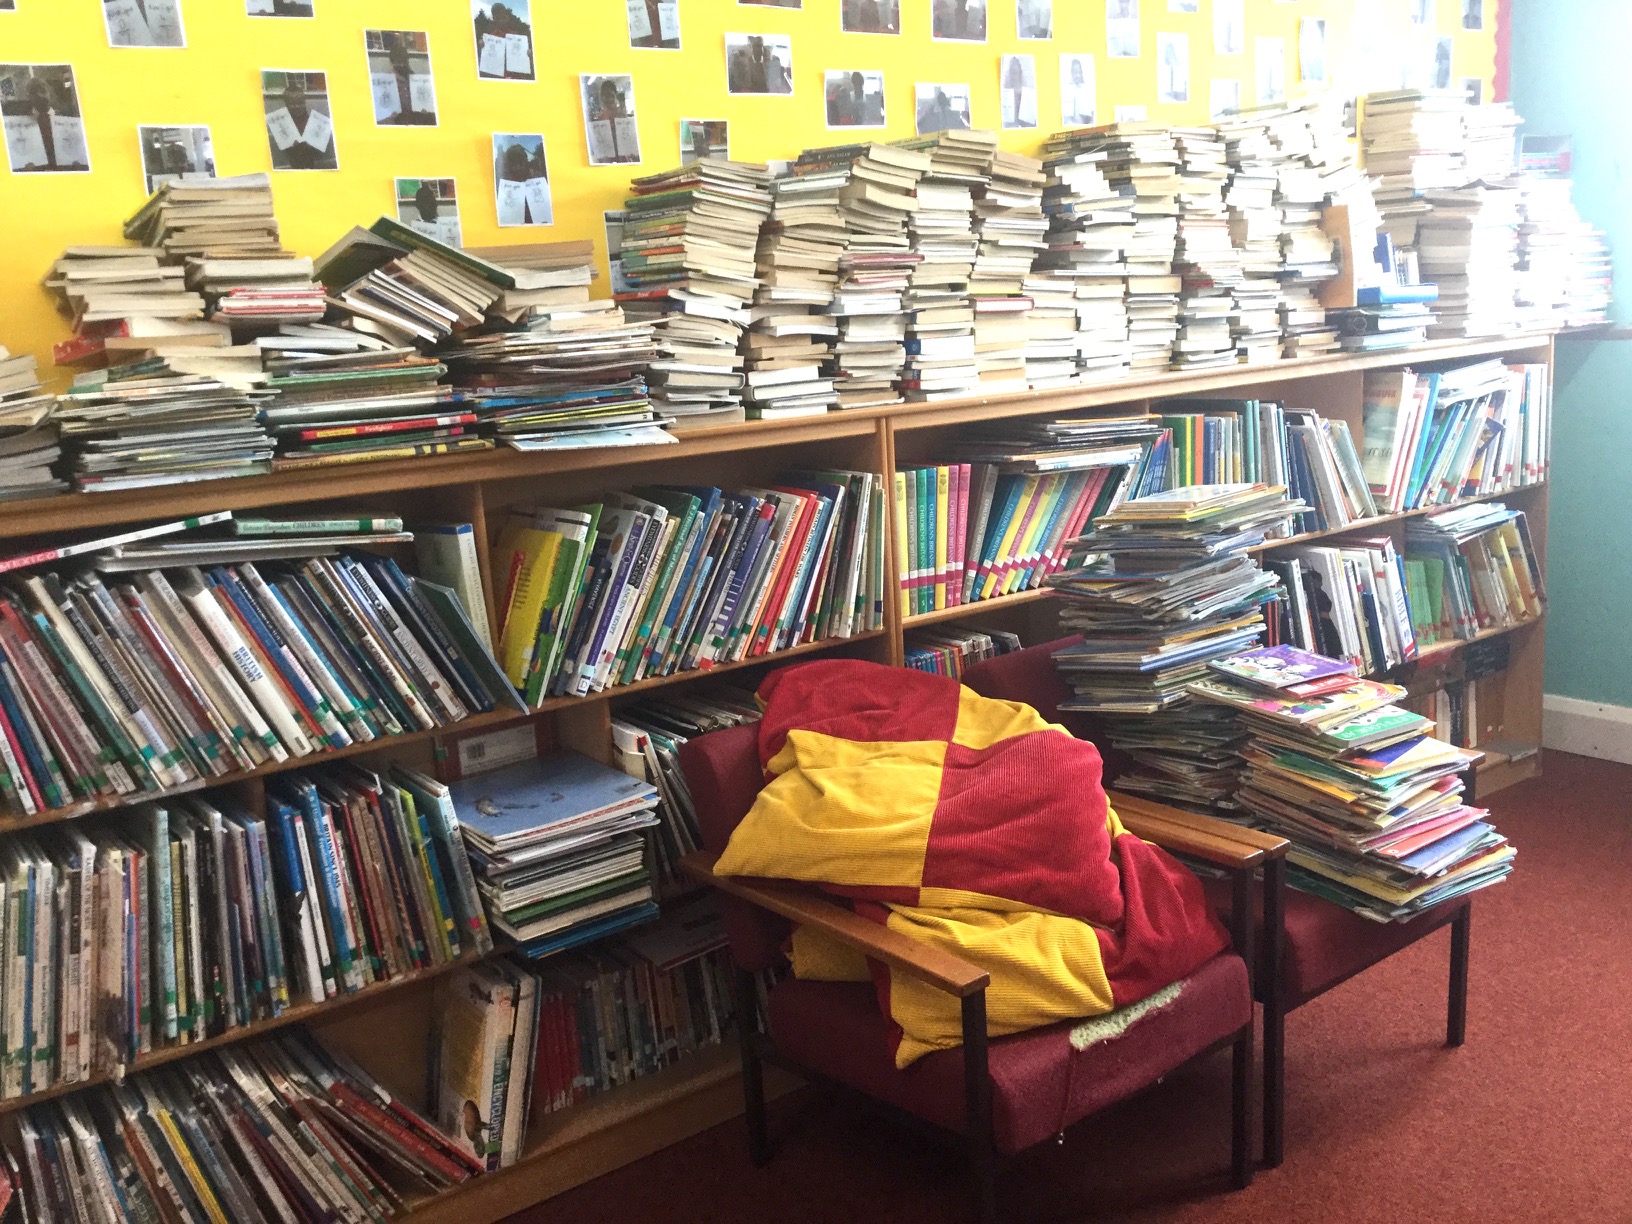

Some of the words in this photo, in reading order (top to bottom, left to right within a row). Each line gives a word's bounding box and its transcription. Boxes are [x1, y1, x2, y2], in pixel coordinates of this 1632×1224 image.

[673, 540, 682, 553] Age
[659, 560, 674, 589] Machines
[794, 563, 803, 579] WARS
[616, 586, 631, 613] ANCIENT
[1394, 589, 1407, 625] BIBLE
[608, 614, 621, 635] EGYPT
[231, 650, 256, 683] HISTORY
[237, 645, 263, 680] BRITISH
[318, 837, 329, 866] Freedom
[488, 1082, 503, 1141] ENCYCLOPED
